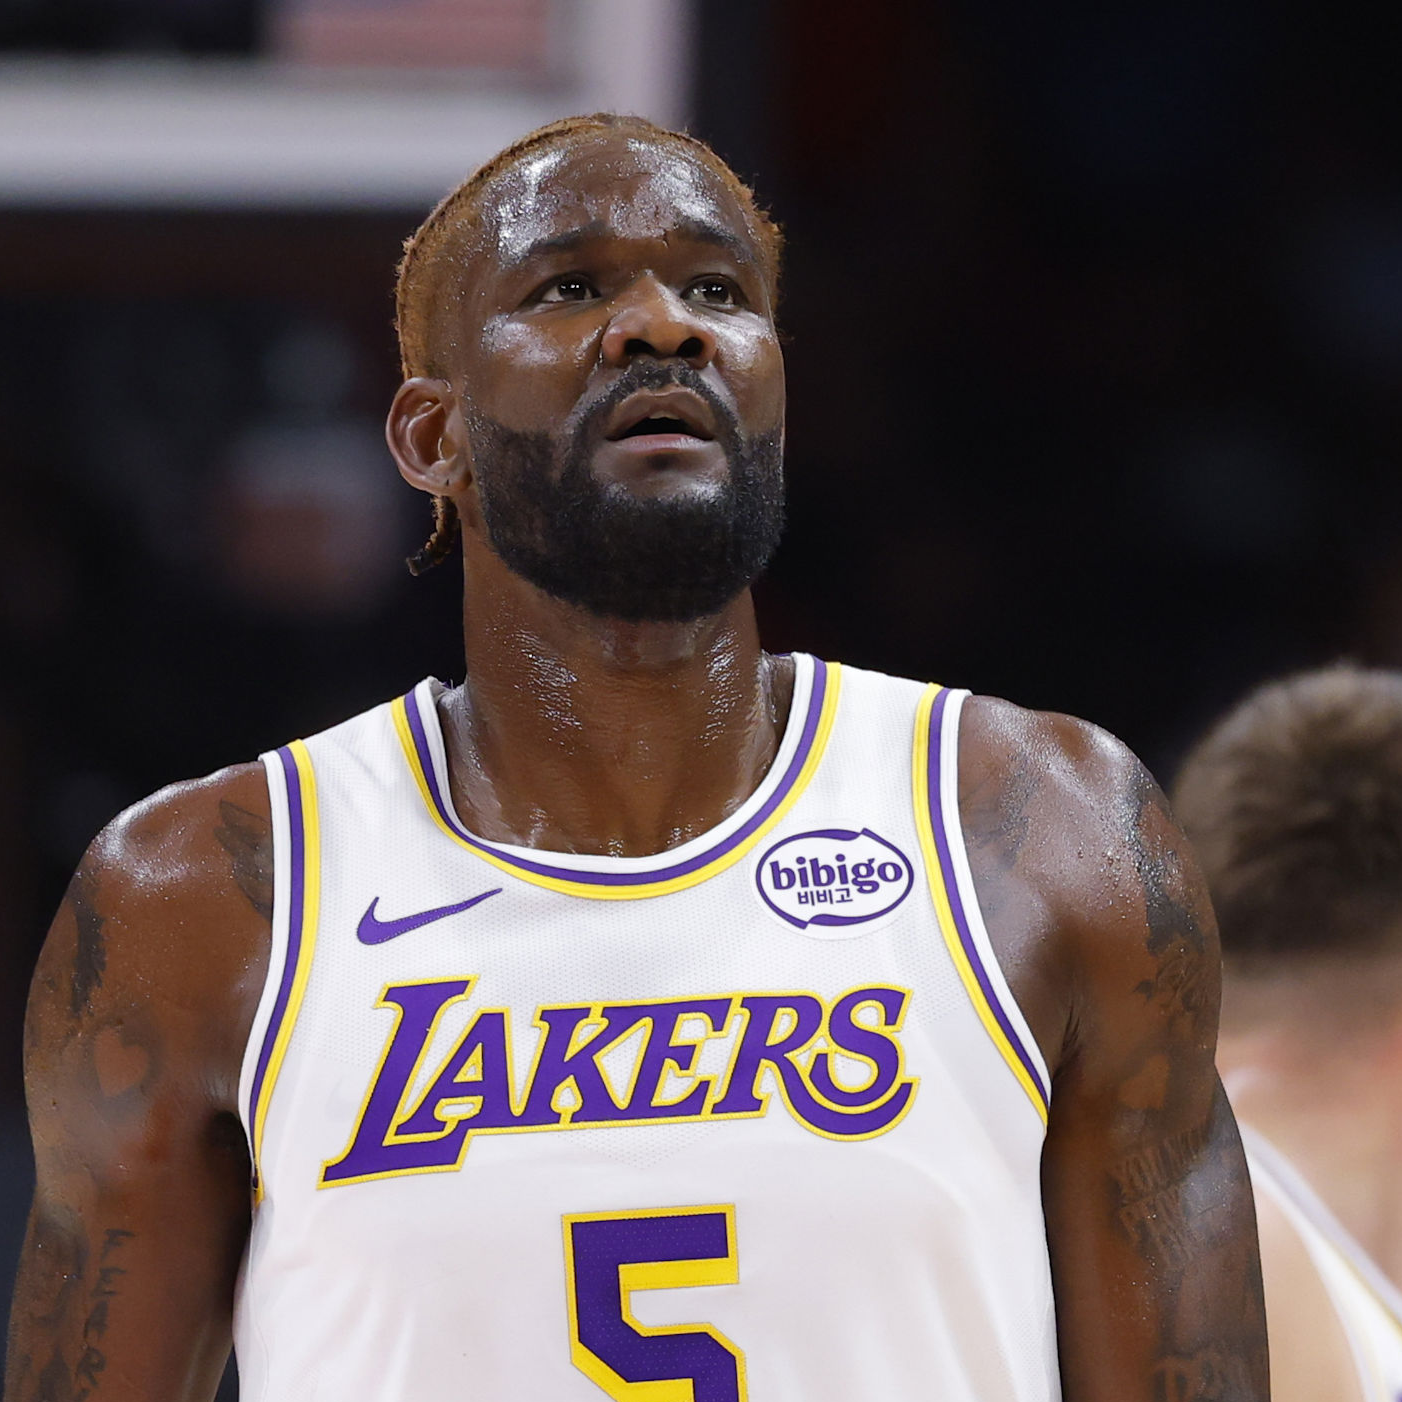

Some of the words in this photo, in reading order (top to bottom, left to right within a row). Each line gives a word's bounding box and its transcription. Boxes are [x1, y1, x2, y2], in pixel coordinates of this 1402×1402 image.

[770, 853, 903, 894] bibigo
[798, 888, 853, 906] 비비고
[316, 974, 921, 1190] LAKERS
